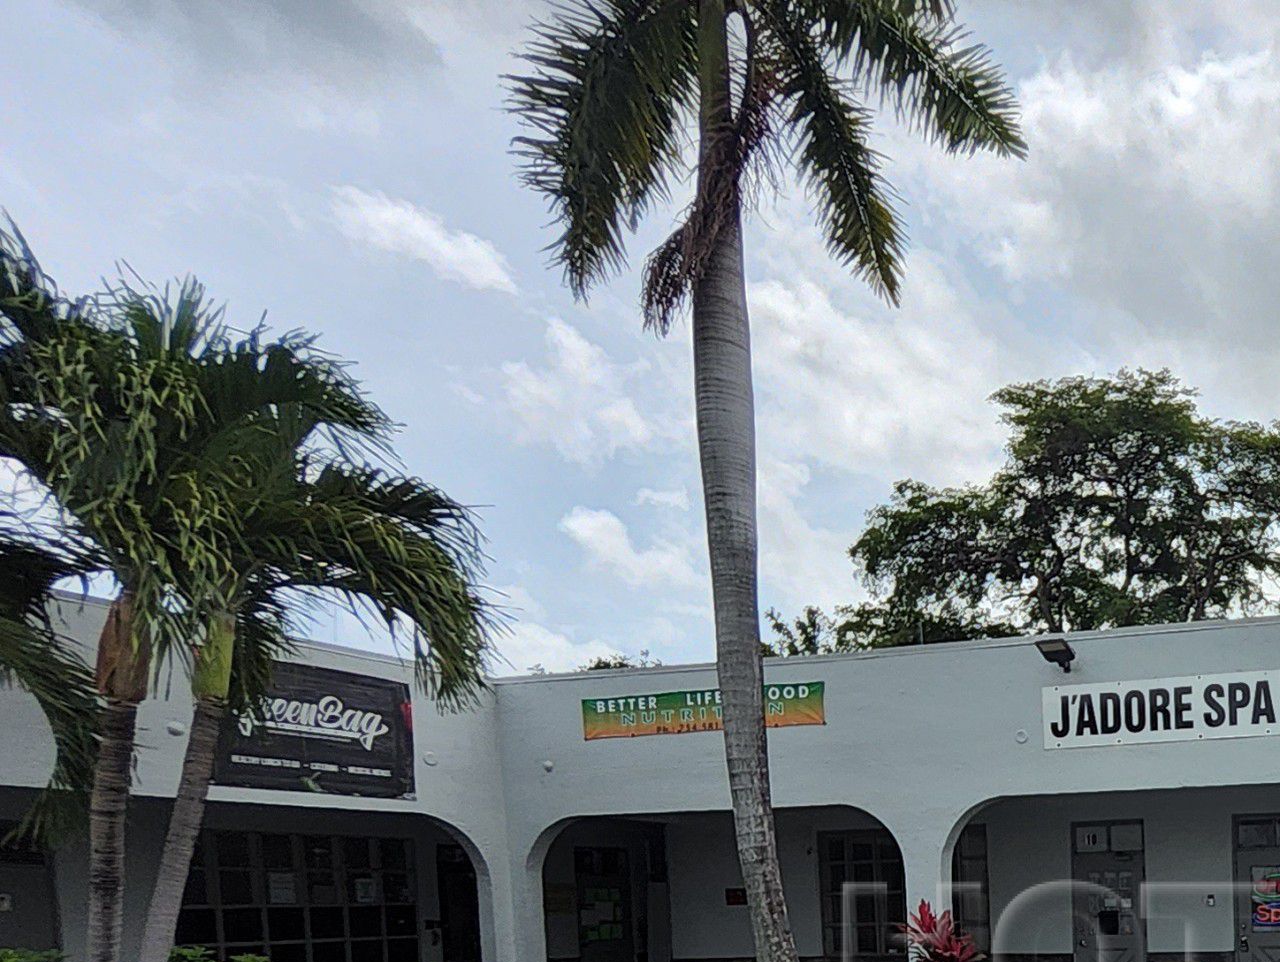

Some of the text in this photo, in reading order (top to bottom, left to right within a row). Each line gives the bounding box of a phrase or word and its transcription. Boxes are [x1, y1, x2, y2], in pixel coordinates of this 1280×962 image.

[596, 685, 810, 714] BETTER LIFE OOD
[621, 701, 785, 726] NUTRITN
[1050, 680, 1277, 738] J'ADORE SPA
